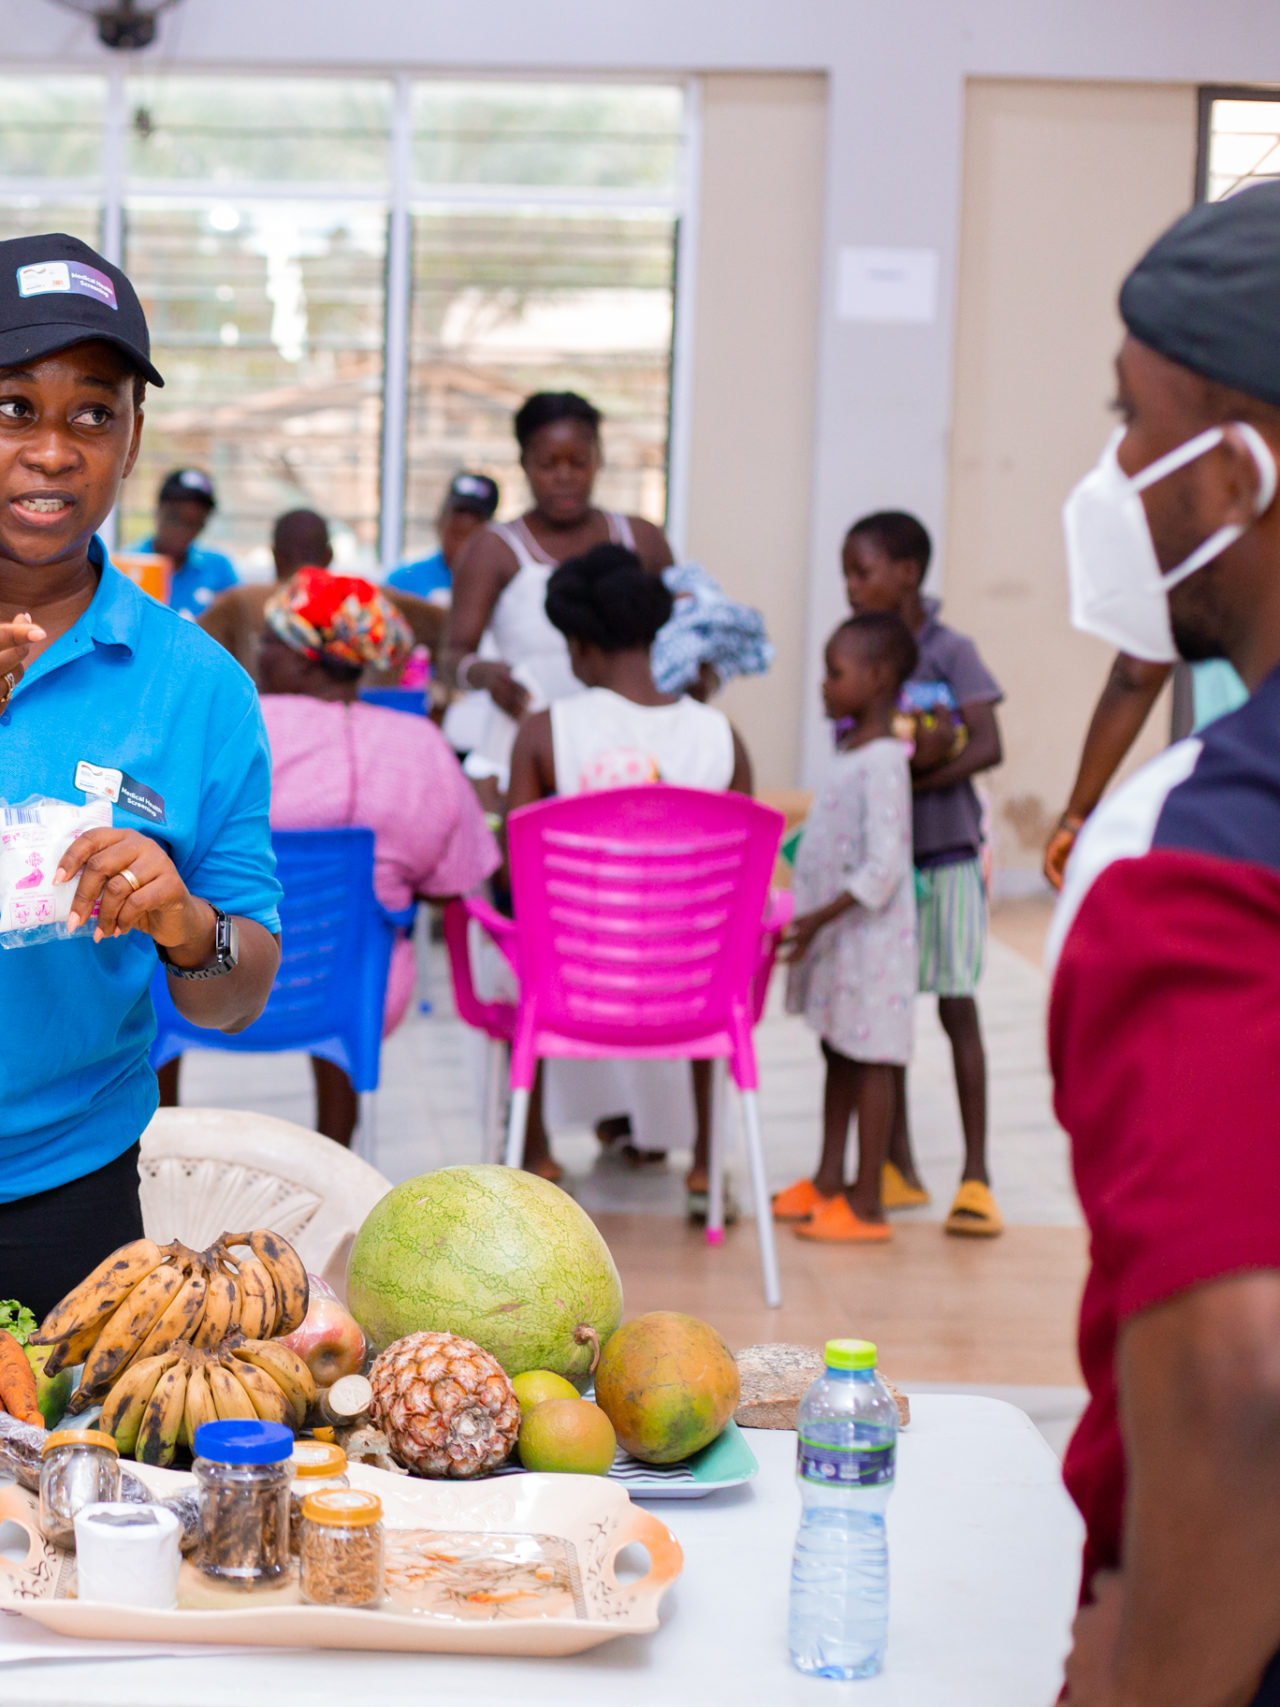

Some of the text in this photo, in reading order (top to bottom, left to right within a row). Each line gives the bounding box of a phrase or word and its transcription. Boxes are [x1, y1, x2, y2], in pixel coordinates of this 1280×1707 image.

[121, 787, 162, 814] Medical Health
[127, 797, 157, 817] Screening
